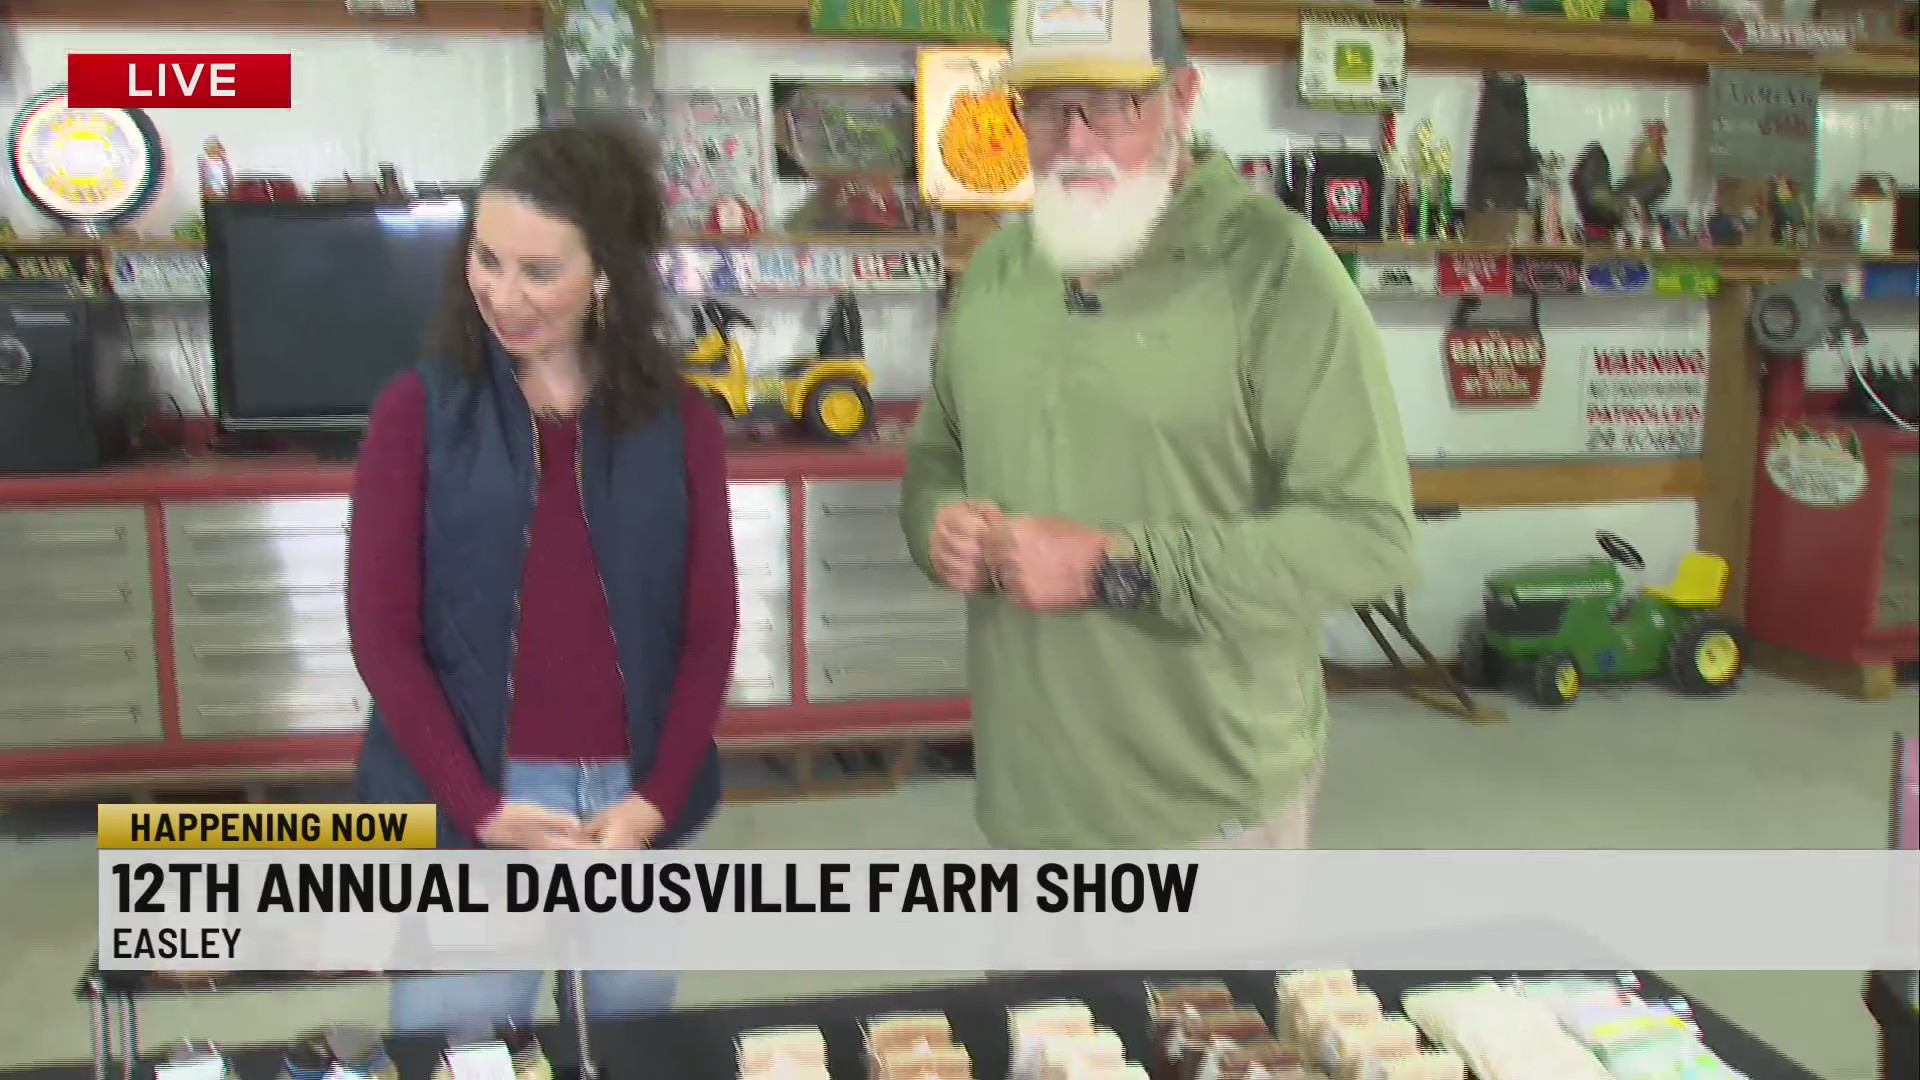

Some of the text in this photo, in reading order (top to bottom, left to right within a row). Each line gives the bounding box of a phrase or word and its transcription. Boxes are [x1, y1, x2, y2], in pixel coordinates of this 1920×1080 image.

[1450, 338, 1542, 367] GARAGE
[1594, 348, 1706, 375] WARNING
[1587, 403, 1700, 425] PATROLLED
